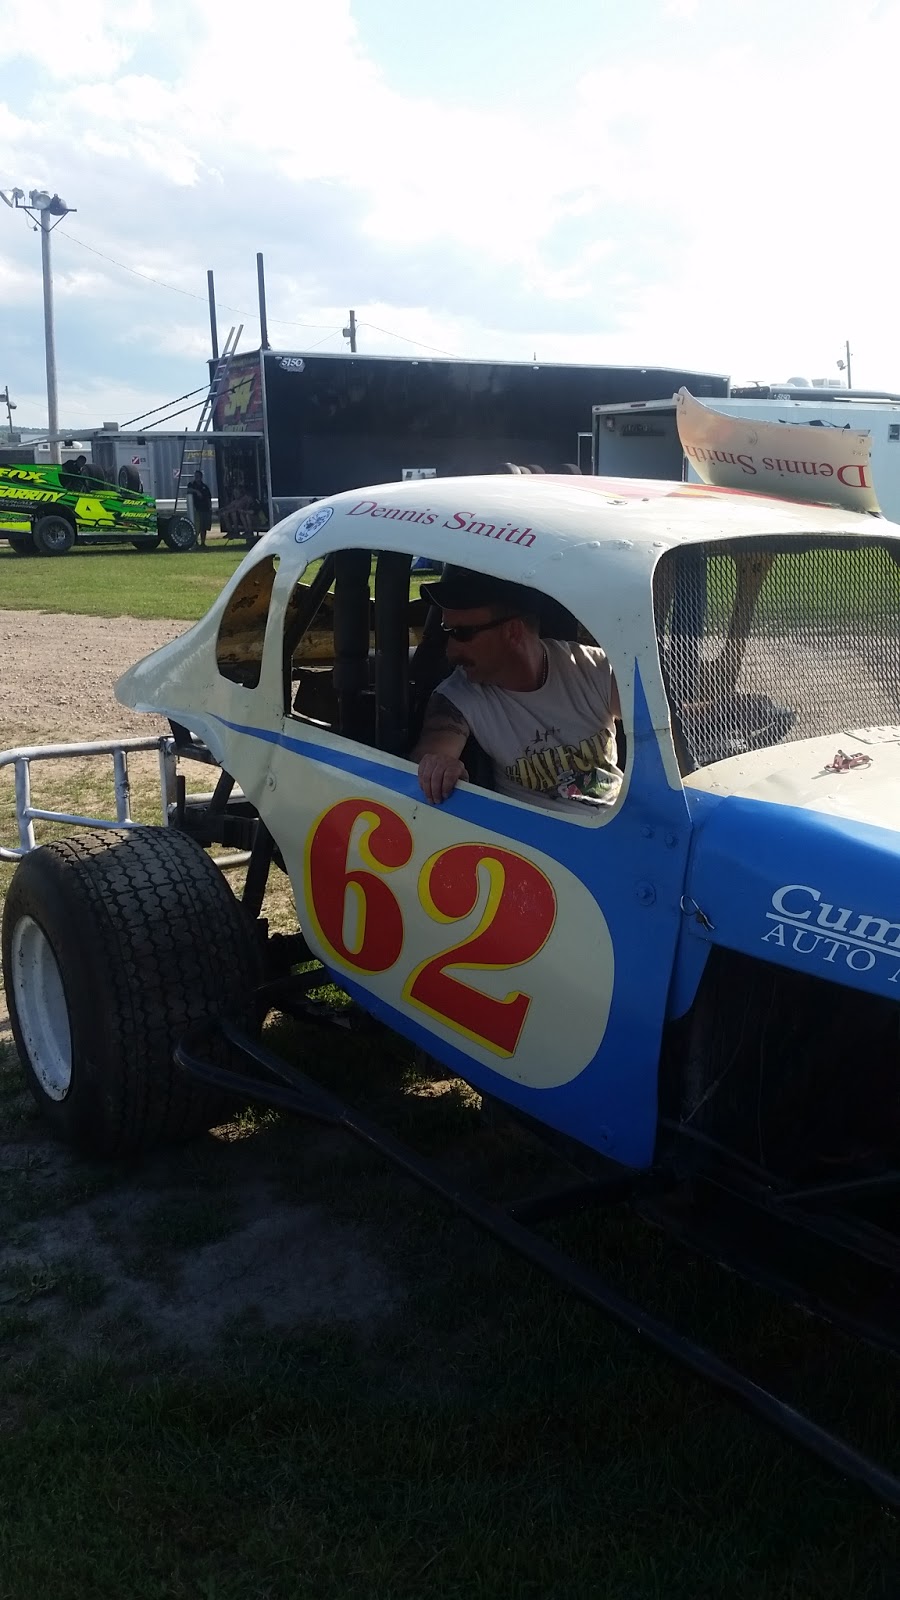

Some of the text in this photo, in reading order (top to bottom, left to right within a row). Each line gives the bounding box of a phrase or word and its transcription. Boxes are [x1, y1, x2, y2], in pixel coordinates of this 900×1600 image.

[684, 445, 872, 489] Dennis Smith
[345, 500, 438, 525] Dennis
[442, 511, 537, 548] Smith
[303, 796, 558, 1060] 62
[761, 923, 876, 971] AUTO
